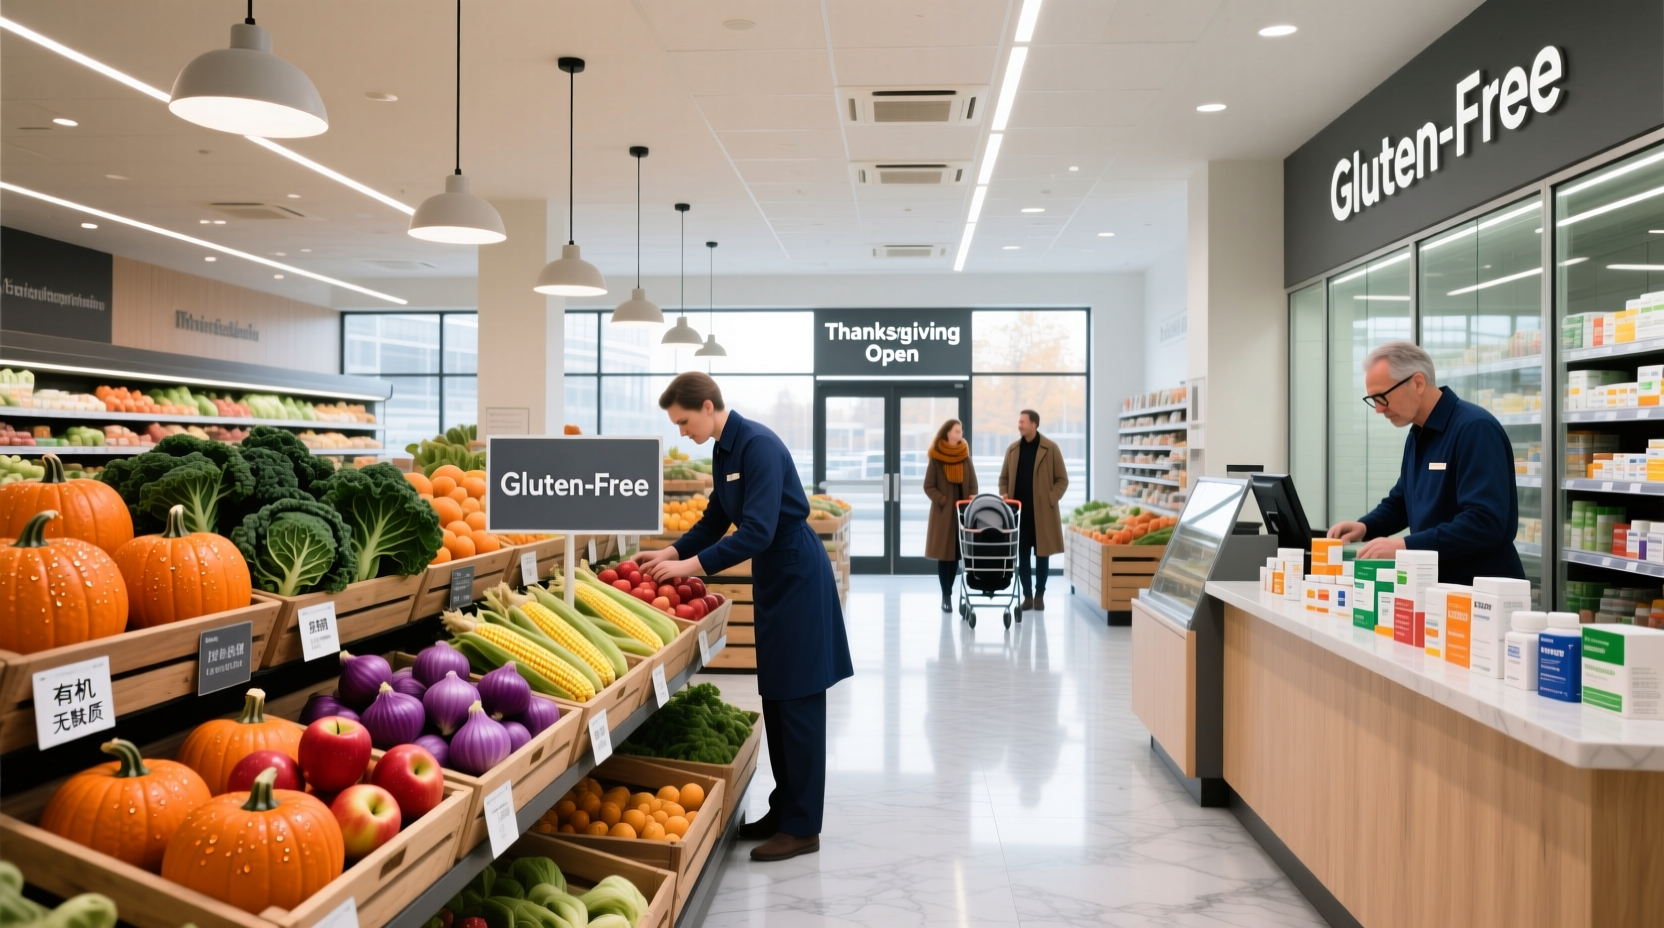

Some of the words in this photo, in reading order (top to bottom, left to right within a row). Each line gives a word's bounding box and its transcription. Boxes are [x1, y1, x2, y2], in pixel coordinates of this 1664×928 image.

[1331, 45, 1562, 221] Gluten-Free
[865, 344, 919, 366] Open
[500, 471, 649, 497] Gluten-Free
[53, 678, 96, 706] 有机
